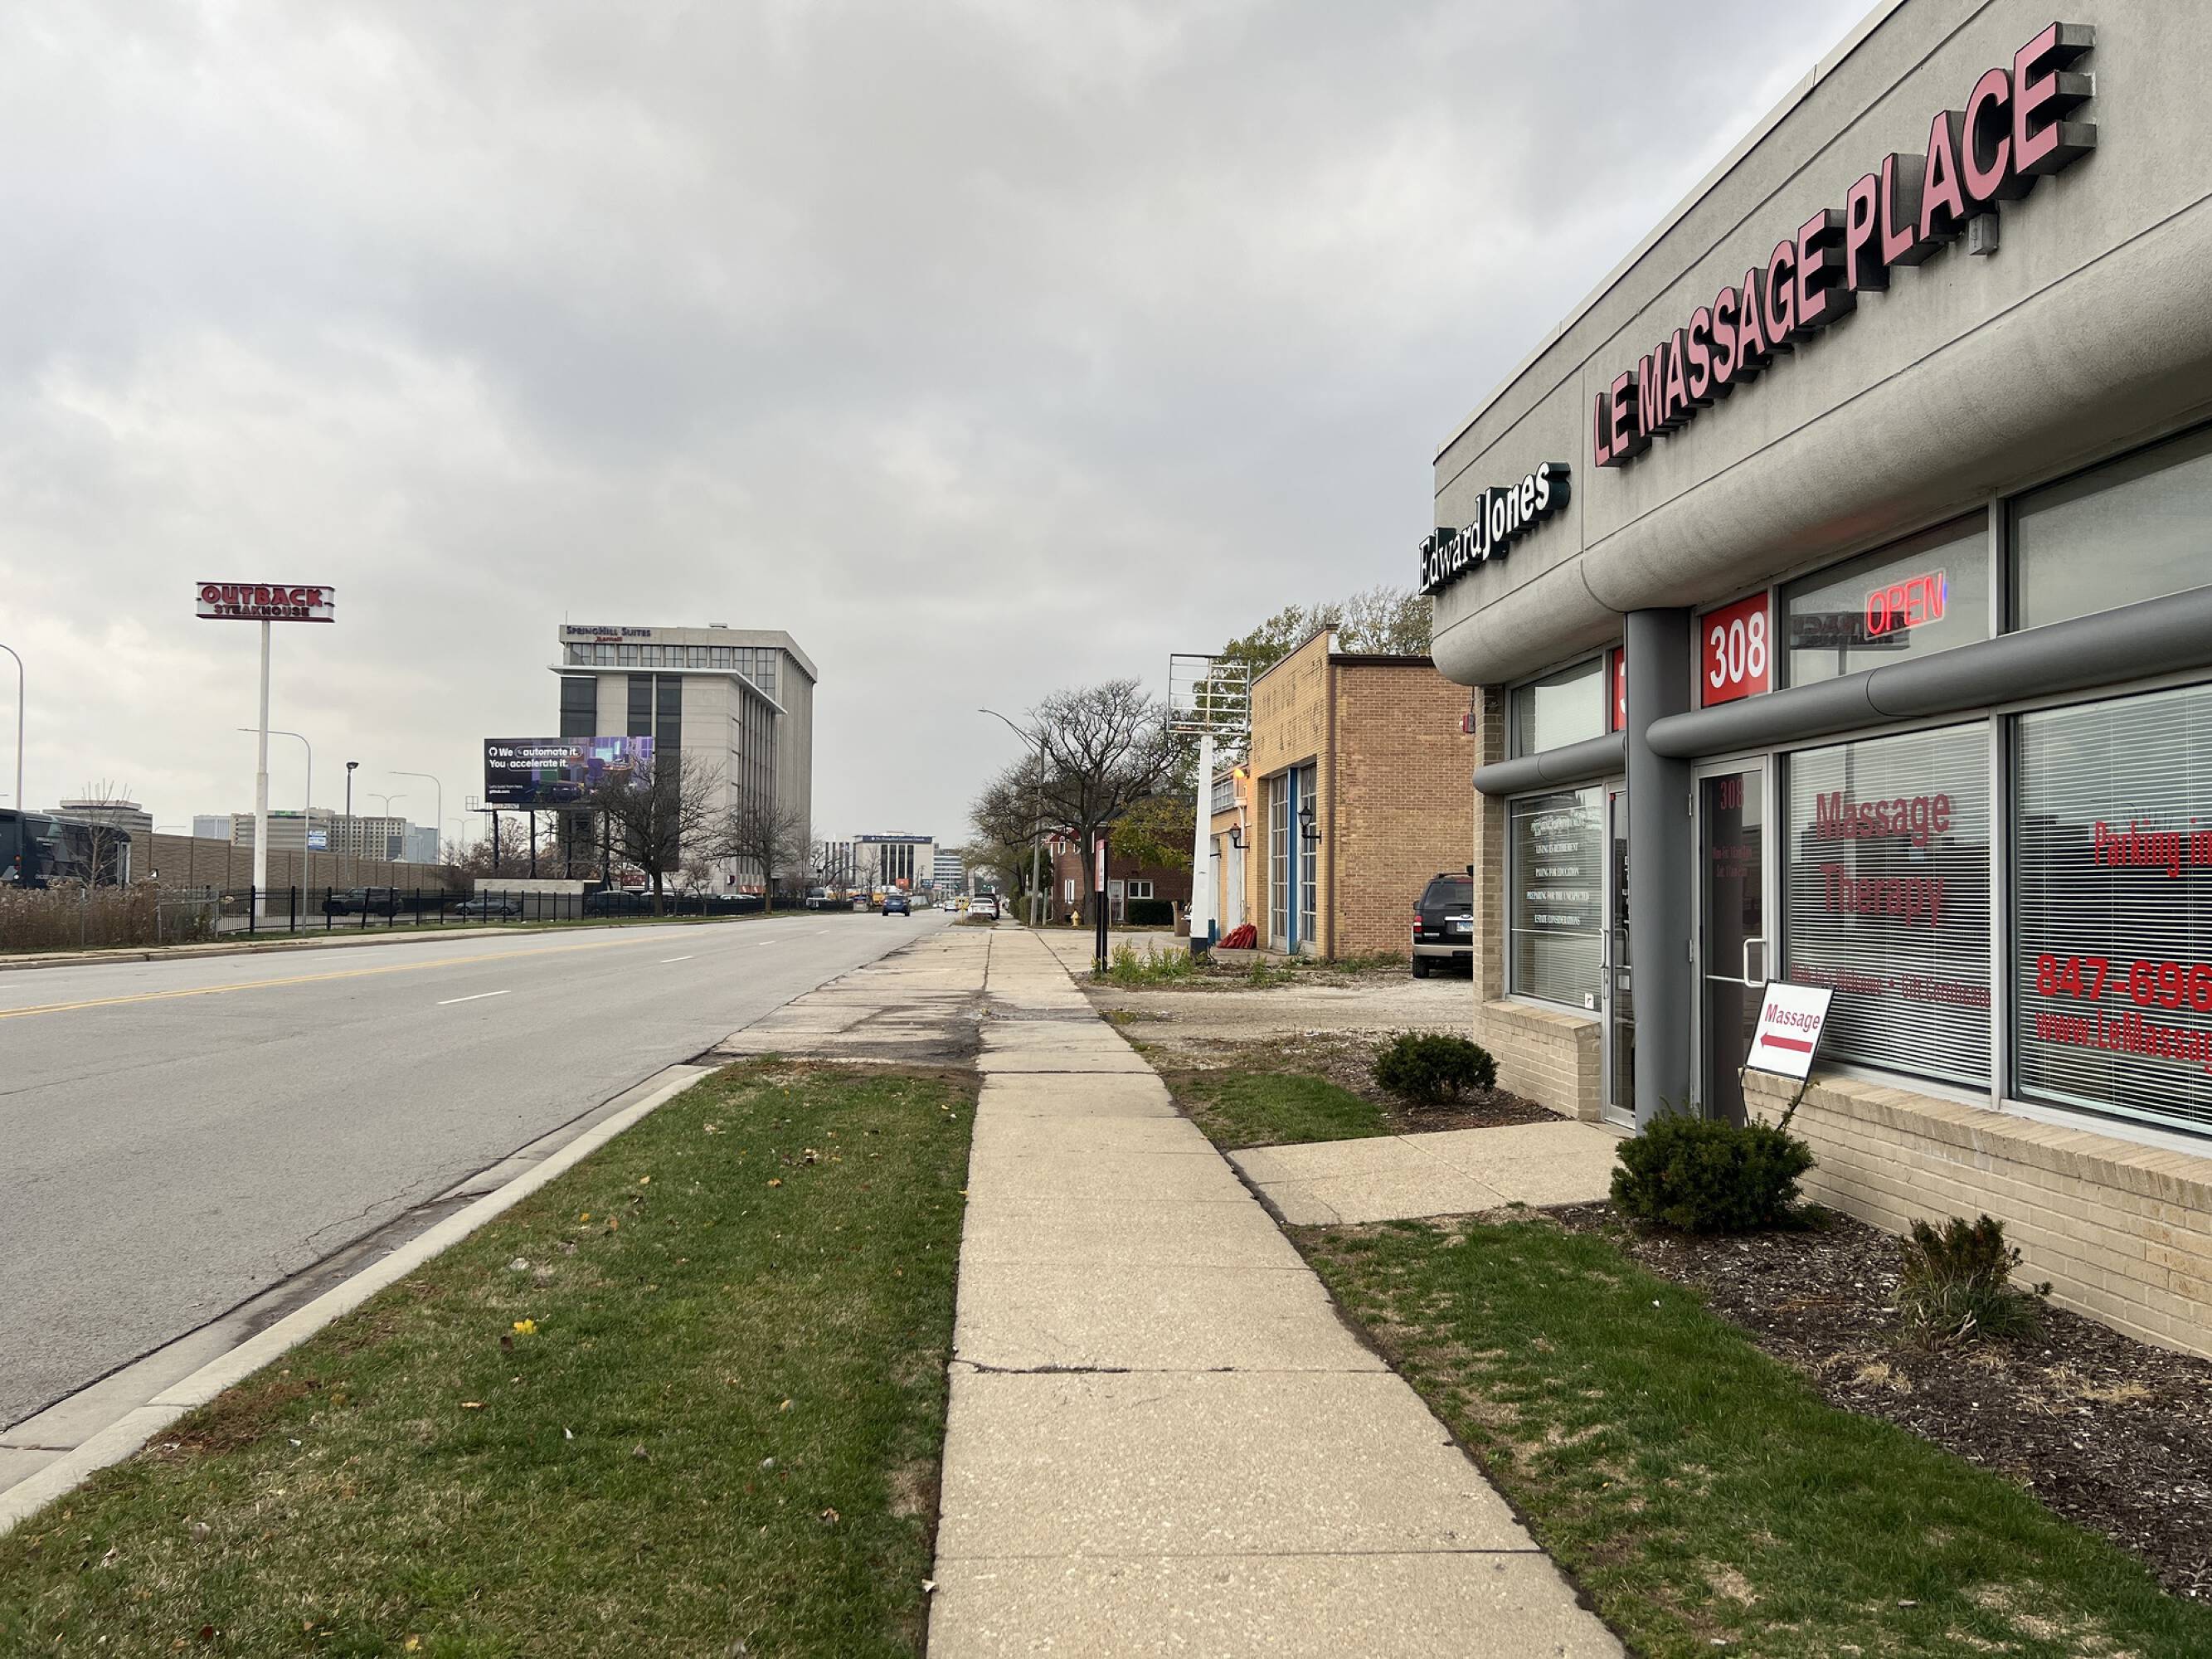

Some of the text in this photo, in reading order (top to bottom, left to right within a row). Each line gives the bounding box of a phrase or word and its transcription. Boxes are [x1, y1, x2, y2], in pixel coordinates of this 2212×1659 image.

[1594, 21, 2065, 467] LE MASSAGE PLACE
[1419, 461, 1553, 595] Edward Jones
[201, 584, 323, 607] OUTBACK
[213, 604, 310, 616] STEAKHOUSE
[1868, 572, 1943, 634] OPEN
[1709, 611, 1766, 688] 308
[489, 759, 569, 768] You accelerate it.
[498, 747, 579, 757] We automate it.
[1720, 778, 1744, 810] 308
[1816, 791, 1950, 847] Massage
[2094, 820, 2180, 878] Parking
[1818, 863, 1945, 928] Therapy
[2036, 954, 2212, 1012] 847-696
[1765, 1003, 1821, 1033] Massage
